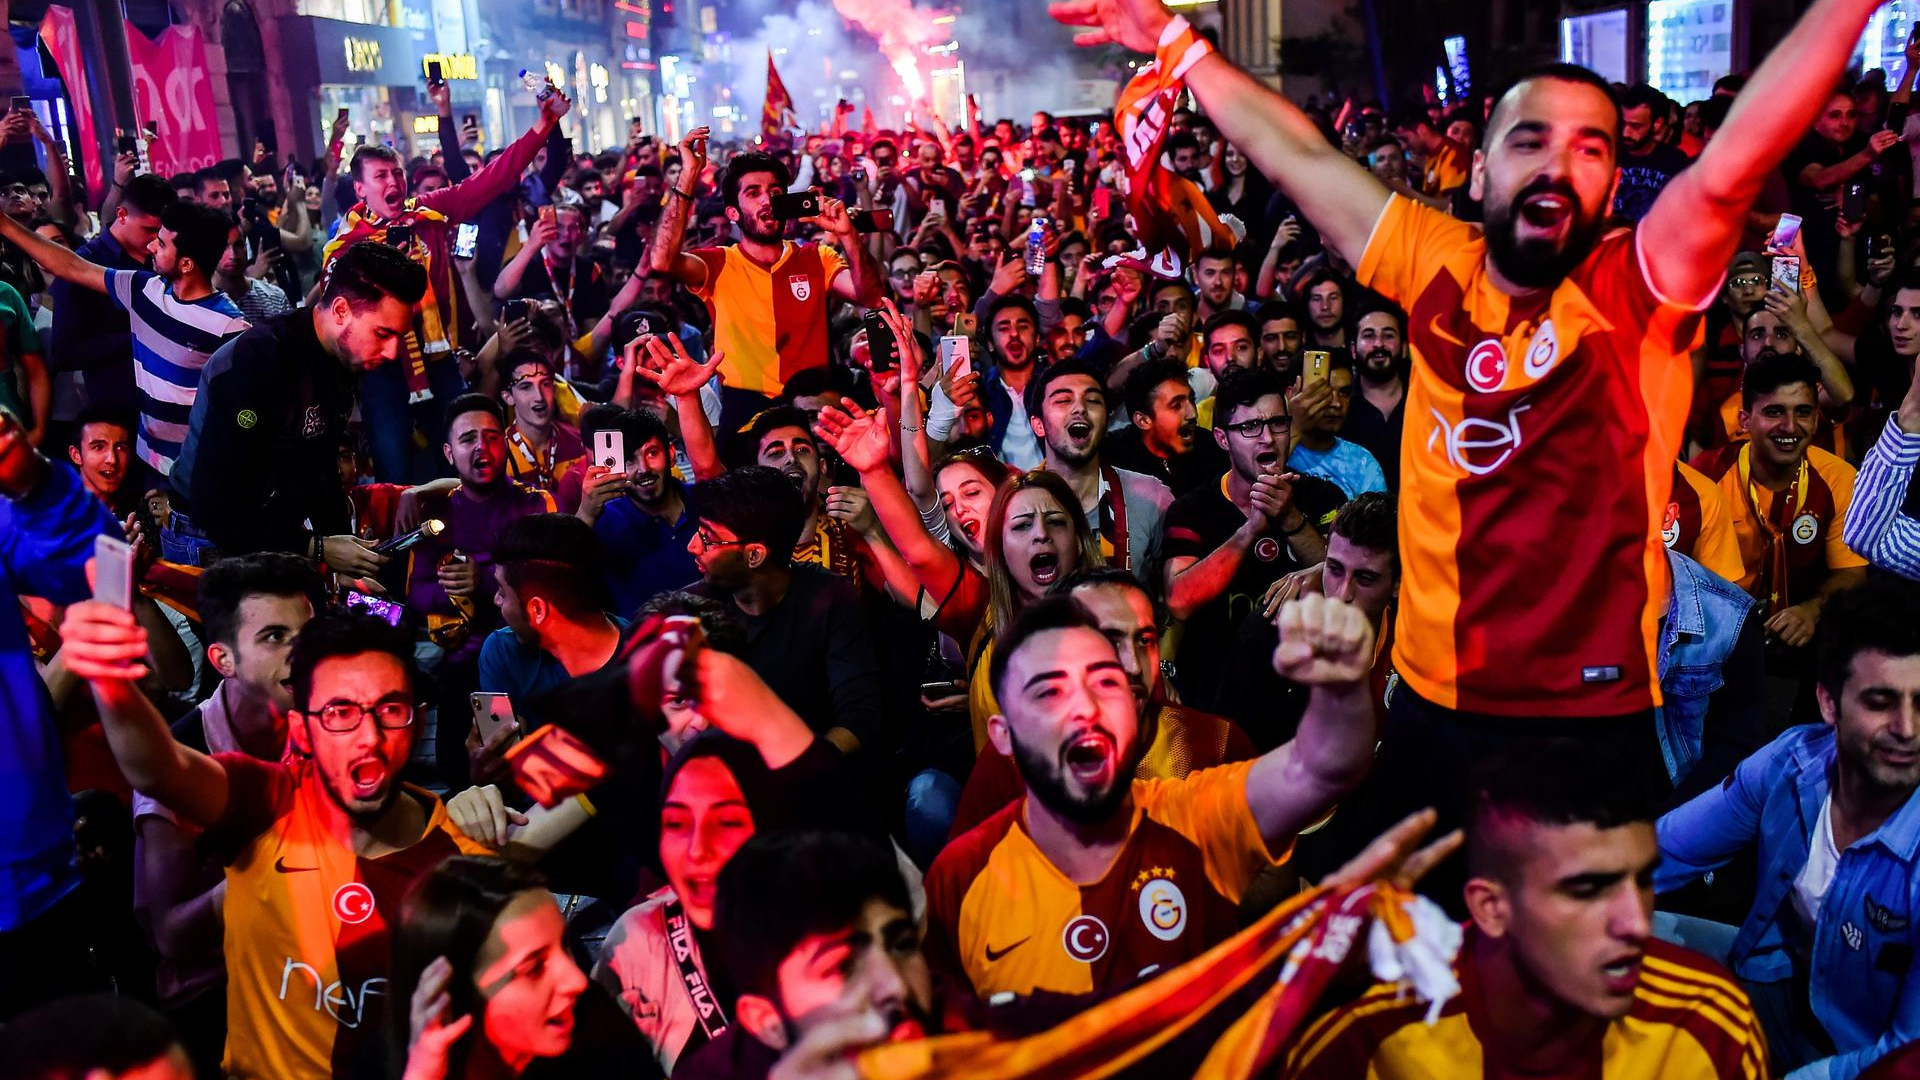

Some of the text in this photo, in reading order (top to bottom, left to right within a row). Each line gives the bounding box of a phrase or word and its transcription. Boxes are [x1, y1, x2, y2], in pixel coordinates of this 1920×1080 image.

[1620, 167, 1671, 180] ACIFIC
[1620, 176, 1662, 188] CEAN
[667, 915, 715, 1019] FILA FILA
